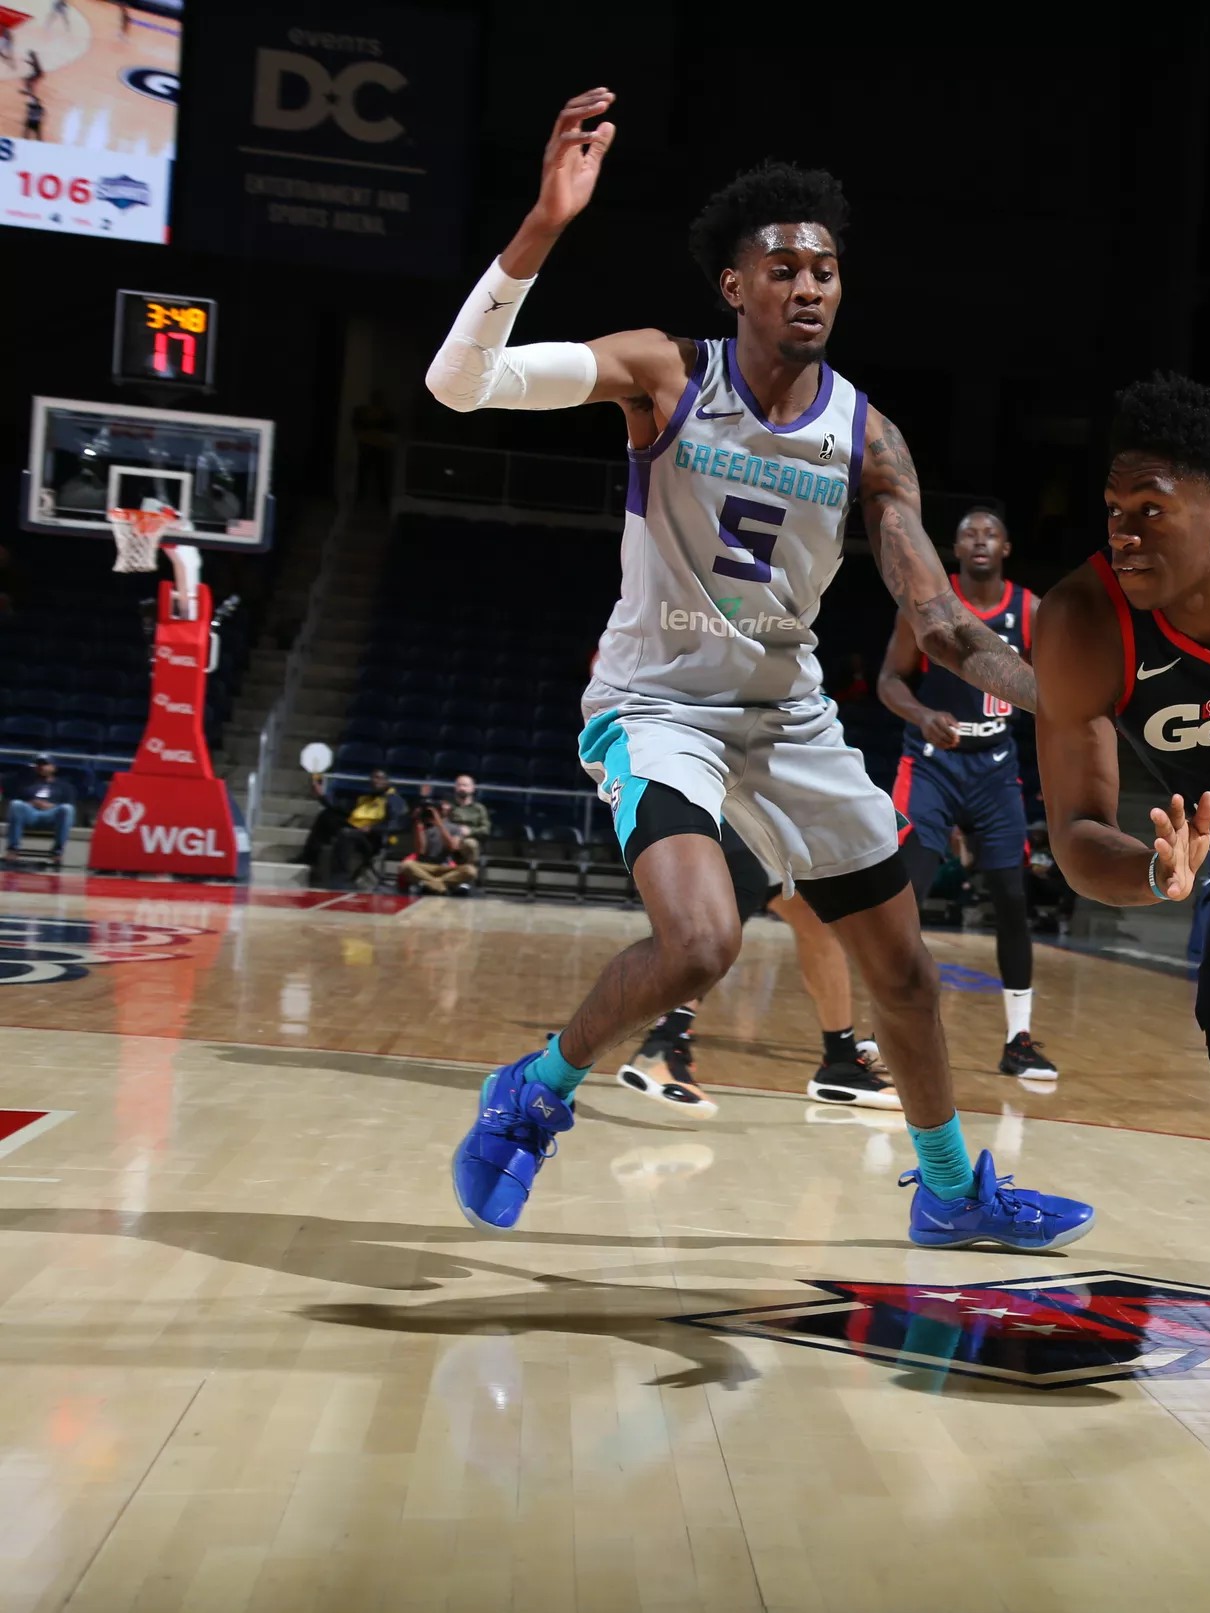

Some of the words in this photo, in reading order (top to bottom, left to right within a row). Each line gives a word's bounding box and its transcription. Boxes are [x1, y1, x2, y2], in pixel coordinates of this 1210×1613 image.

[287, 27, 382, 57] events
[251, 46, 409, 143] DC
[17, 171, 91, 204] 106
[377, 188, 410, 213] AND
[152, 331, 196, 375] 17
[675, 440, 846, 507] GREENSBORO
[711, 494, 788, 584] 5
[168, 654, 198, 668] WGL
[166, 701, 196, 715] WGL
[950, 718, 1007, 737] EICO
[160, 748, 197, 764] WGL
[140, 824, 226, 858] WGL
